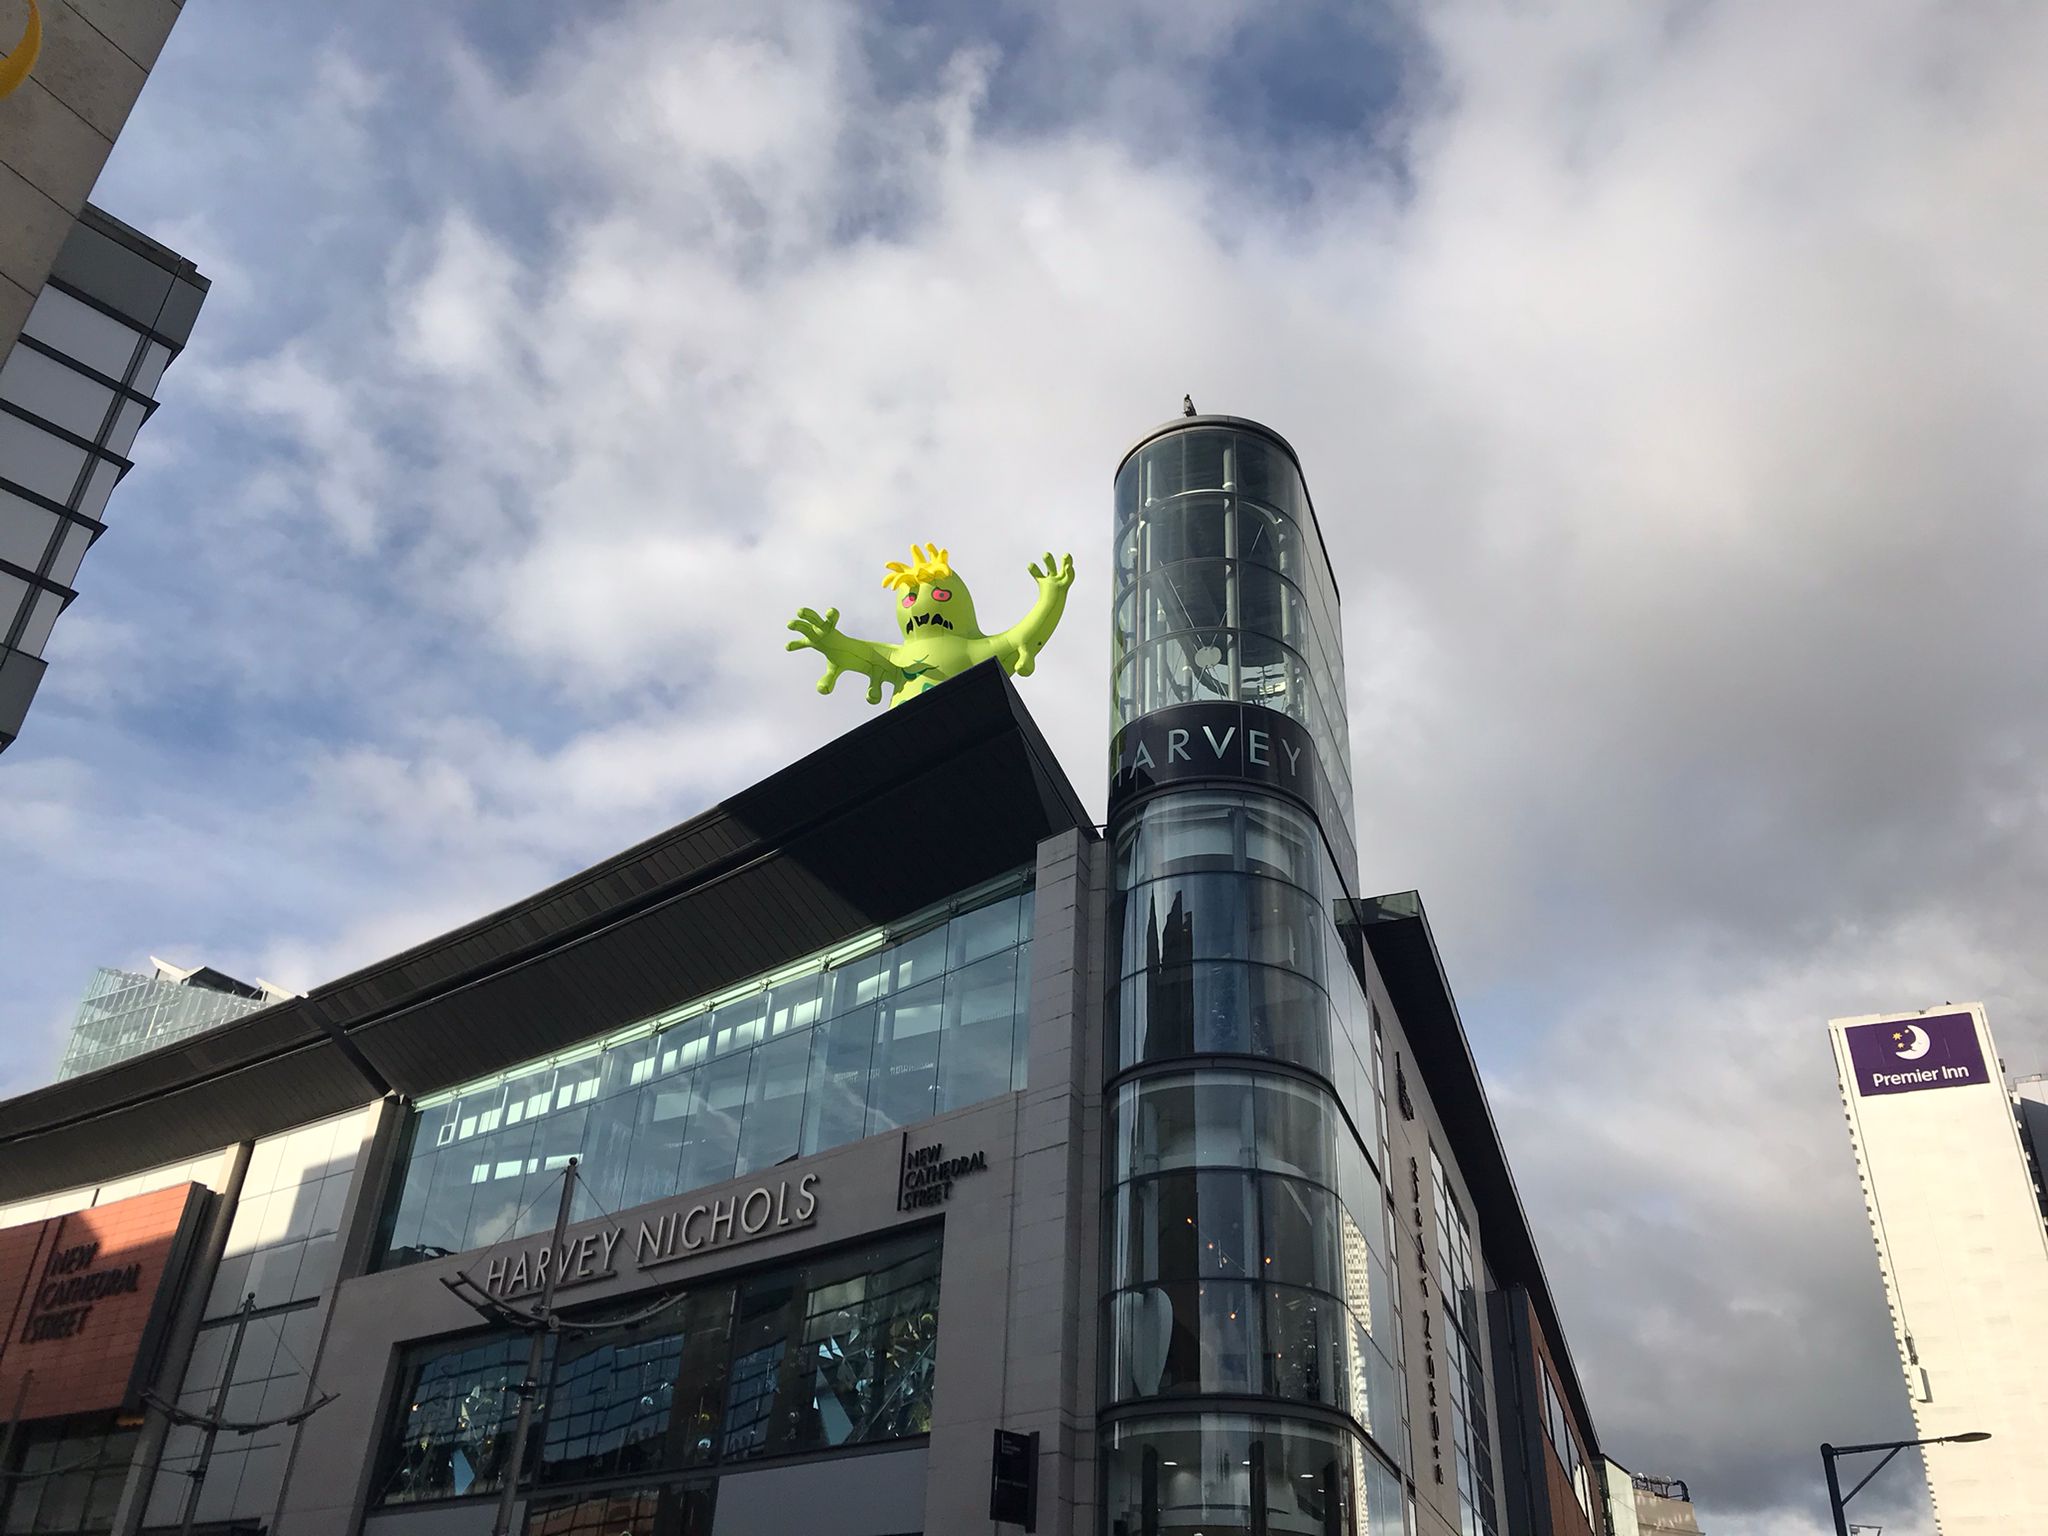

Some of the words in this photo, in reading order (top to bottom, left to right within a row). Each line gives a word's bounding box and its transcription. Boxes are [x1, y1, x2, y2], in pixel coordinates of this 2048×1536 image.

[1872, 1069, 1939, 1087] Premier
[1941, 1065, 1970, 1080] Inn
[905, 1150, 988, 1189] CATHEDRAL
[907, 1143, 943, 1170] NEW
[903, 1181, 953, 1211] STREET
[486, 1227, 624, 1294] HARVEY
[635, 1172, 818, 1264] NICHOLS
